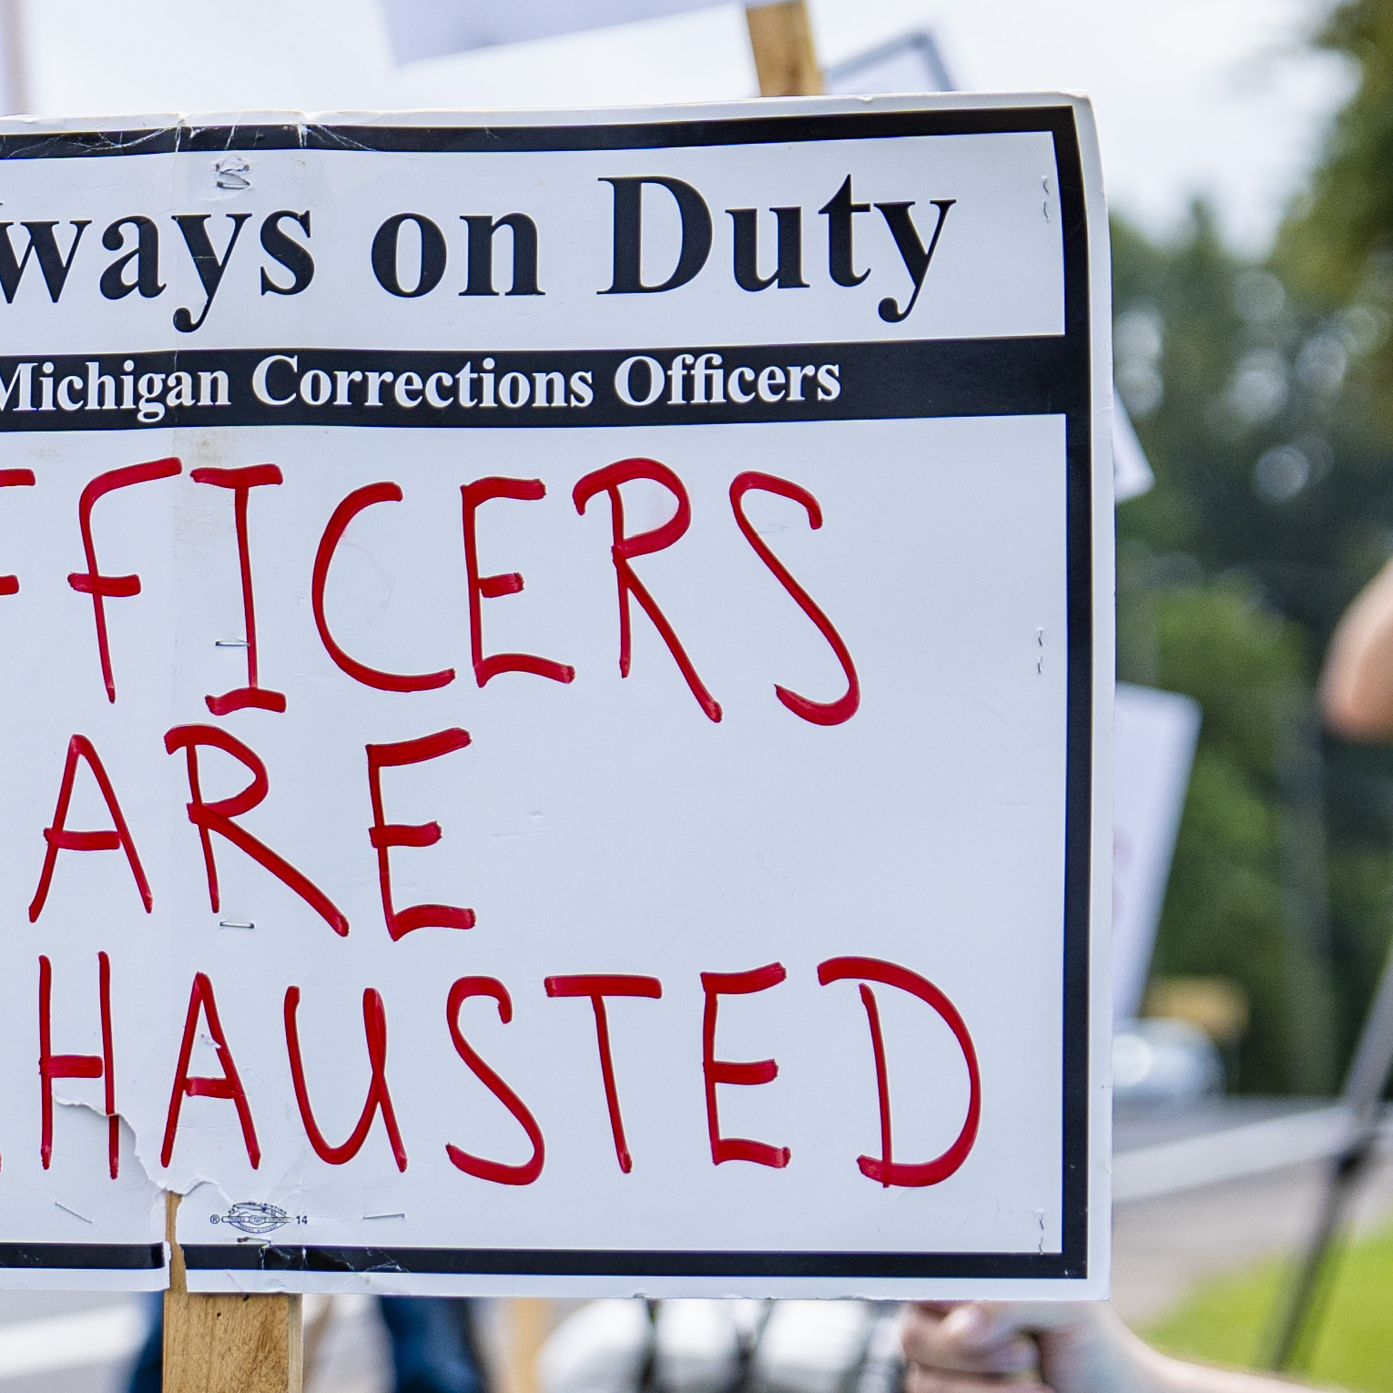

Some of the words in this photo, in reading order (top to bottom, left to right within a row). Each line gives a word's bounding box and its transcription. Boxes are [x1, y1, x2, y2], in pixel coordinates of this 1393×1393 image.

[370, 212, 546, 299] on
[596, 173, 957, 324] Duty
[252, 354, 594, 408] Corrections
[614, 353, 841, 407] Officers
[28, 723, 477, 941] ARE
[295, 1215, 308, 1225] 14
